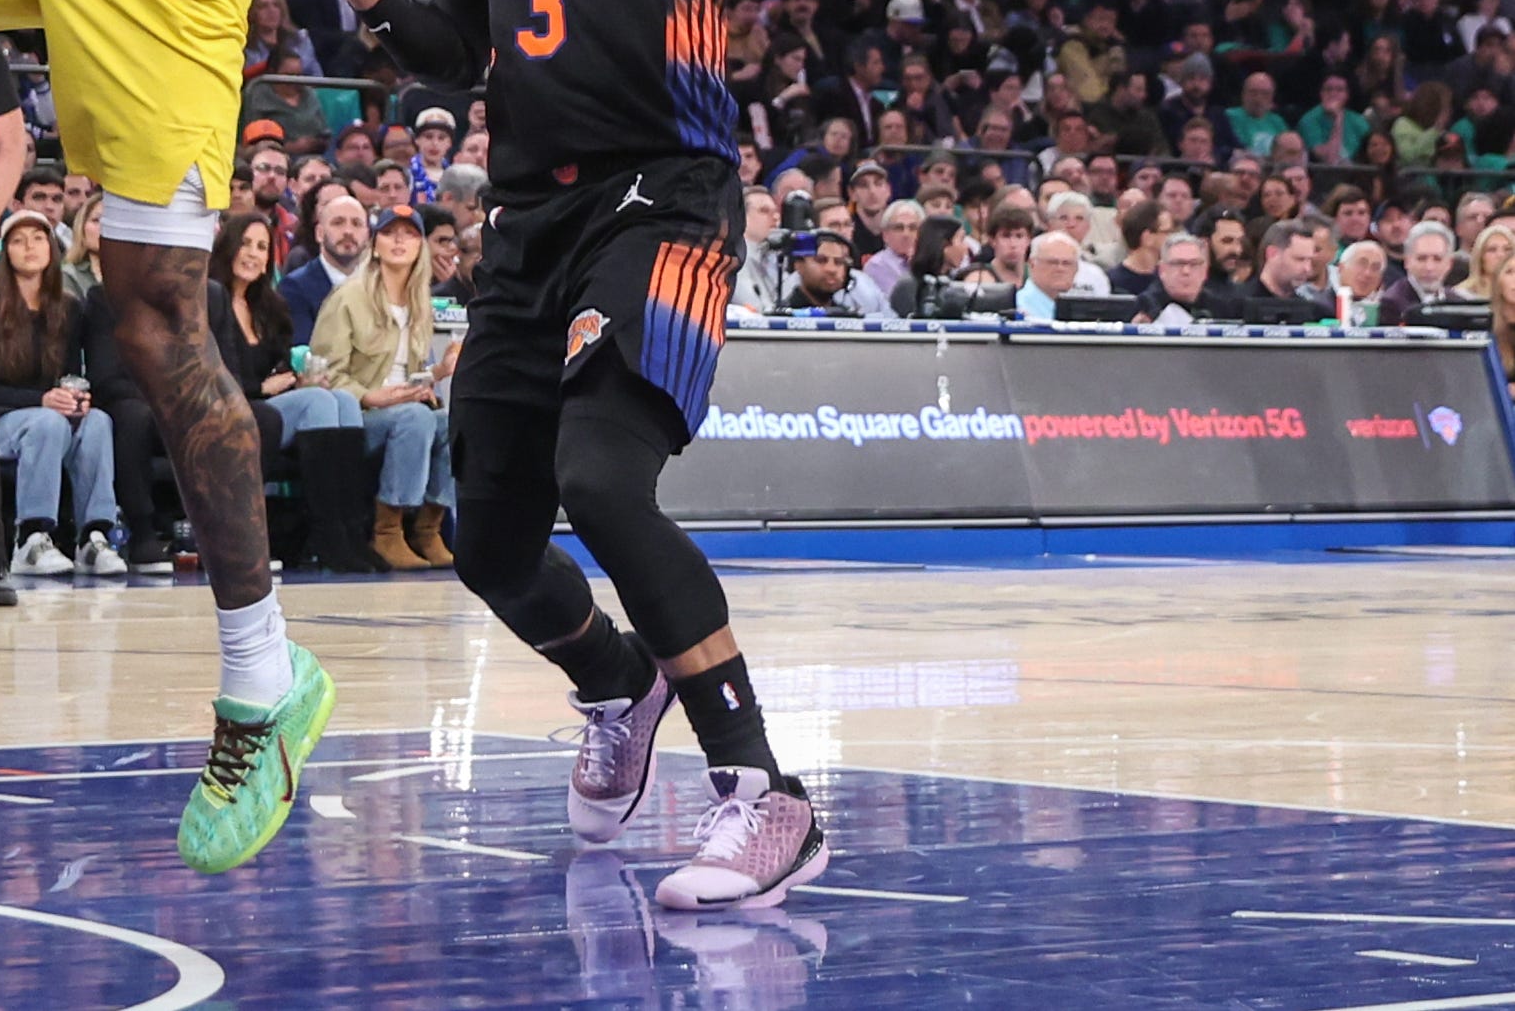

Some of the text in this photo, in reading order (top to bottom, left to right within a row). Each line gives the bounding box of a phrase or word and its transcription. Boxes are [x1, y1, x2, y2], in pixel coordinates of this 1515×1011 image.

[697, 405, 1307, 447] Madison Square Garden powered by Verizon 5G
